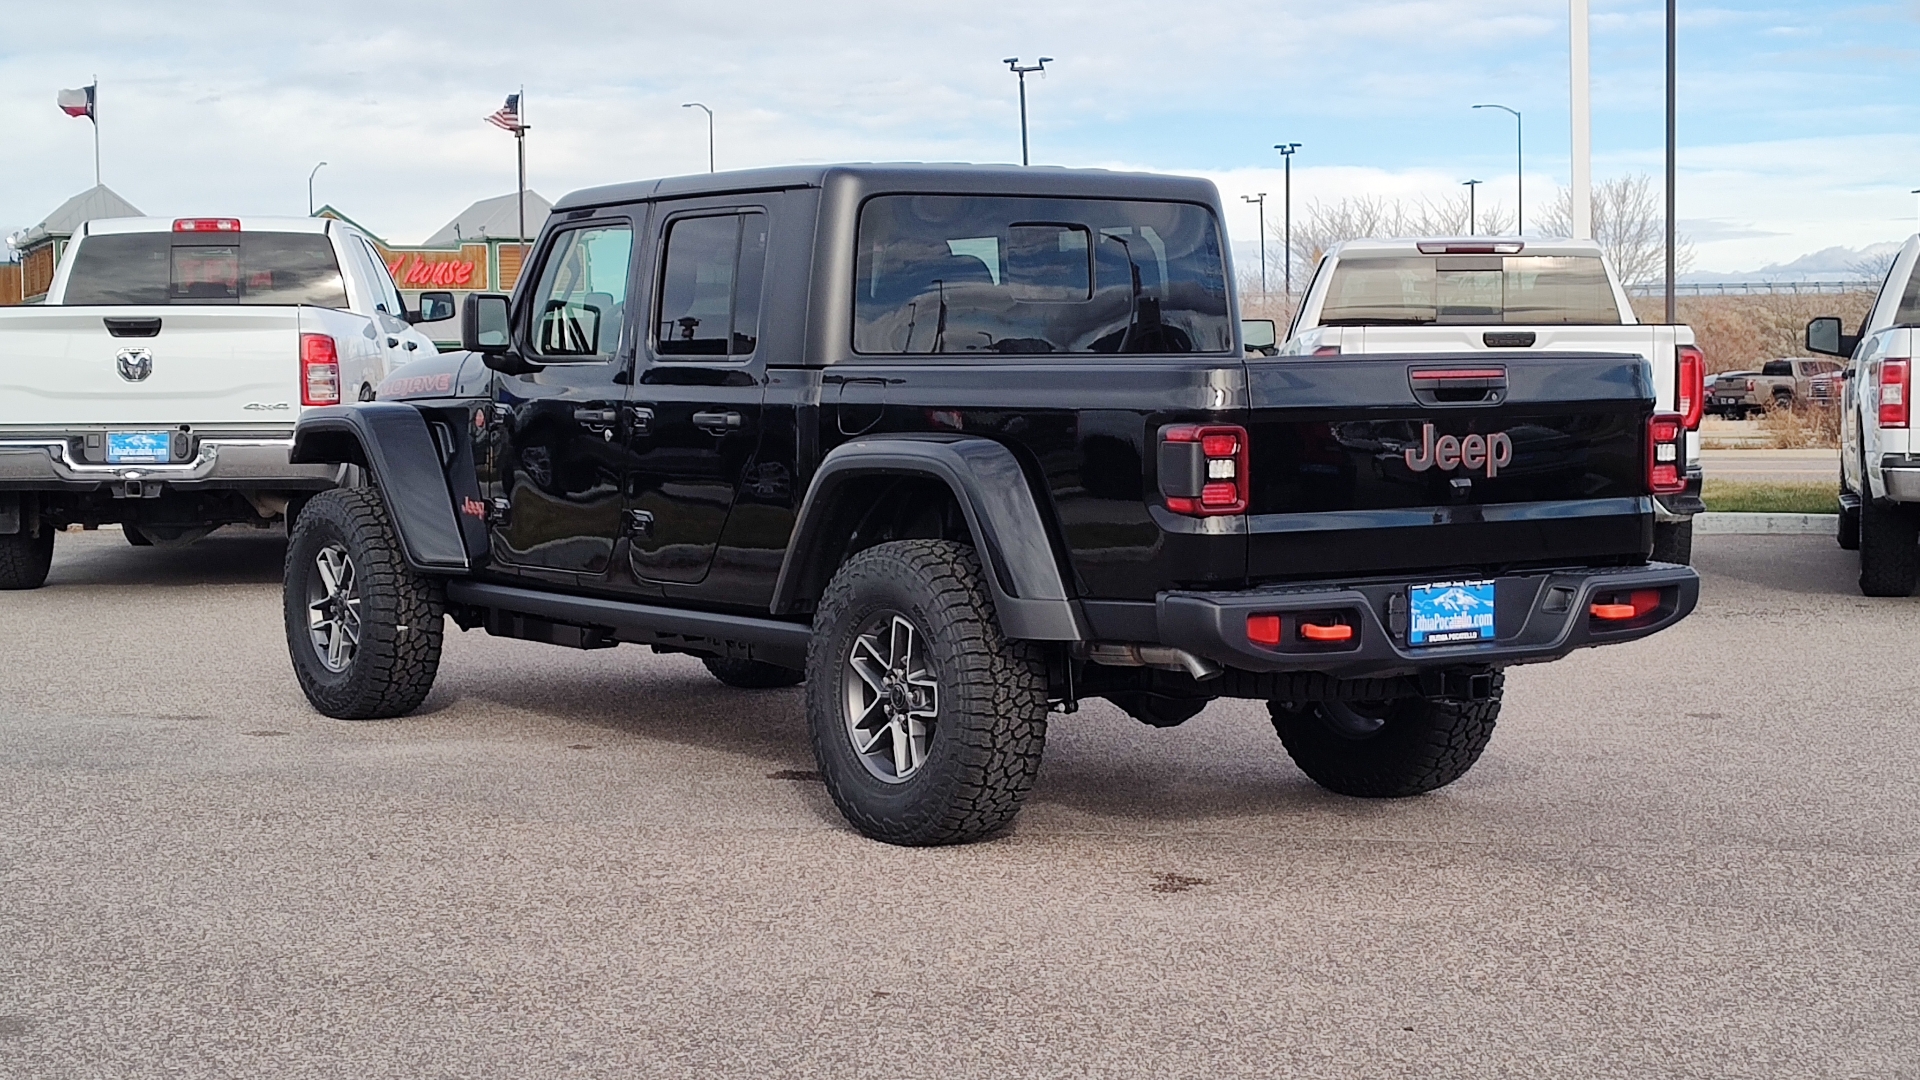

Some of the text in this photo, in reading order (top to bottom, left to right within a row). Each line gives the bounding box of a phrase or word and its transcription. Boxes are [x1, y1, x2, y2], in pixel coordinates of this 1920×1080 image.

[403, 253, 475, 285] house
[243, 402, 291, 411] 4x4
[1405, 423, 1513, 478] Jeep
[461, 496, 485, 520] Jeep
